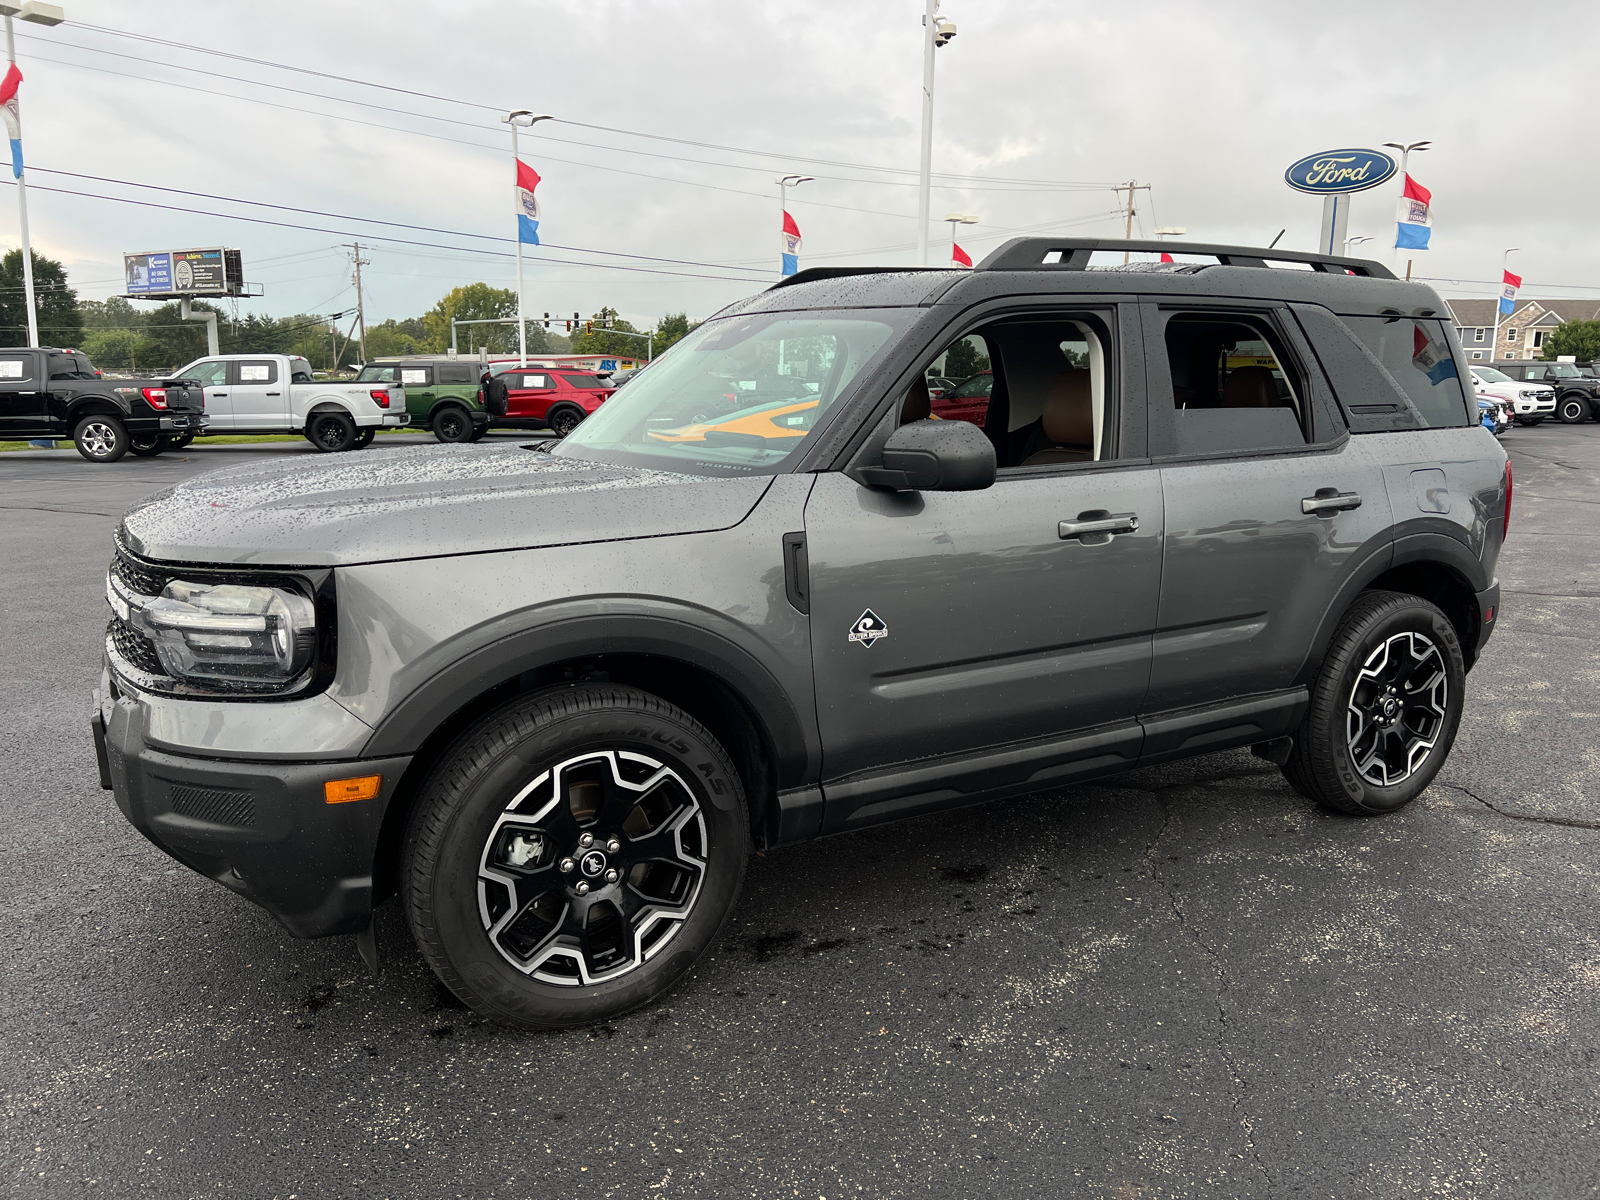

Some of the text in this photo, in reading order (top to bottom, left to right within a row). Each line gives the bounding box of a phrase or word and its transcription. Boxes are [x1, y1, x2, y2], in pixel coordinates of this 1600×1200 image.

[1305, 156, 1372, 185] Ford
[598, 360, 617, 371] ASK
[696, 462, 752, 472] BRONCO
[697, 762, 729, 796] AS
